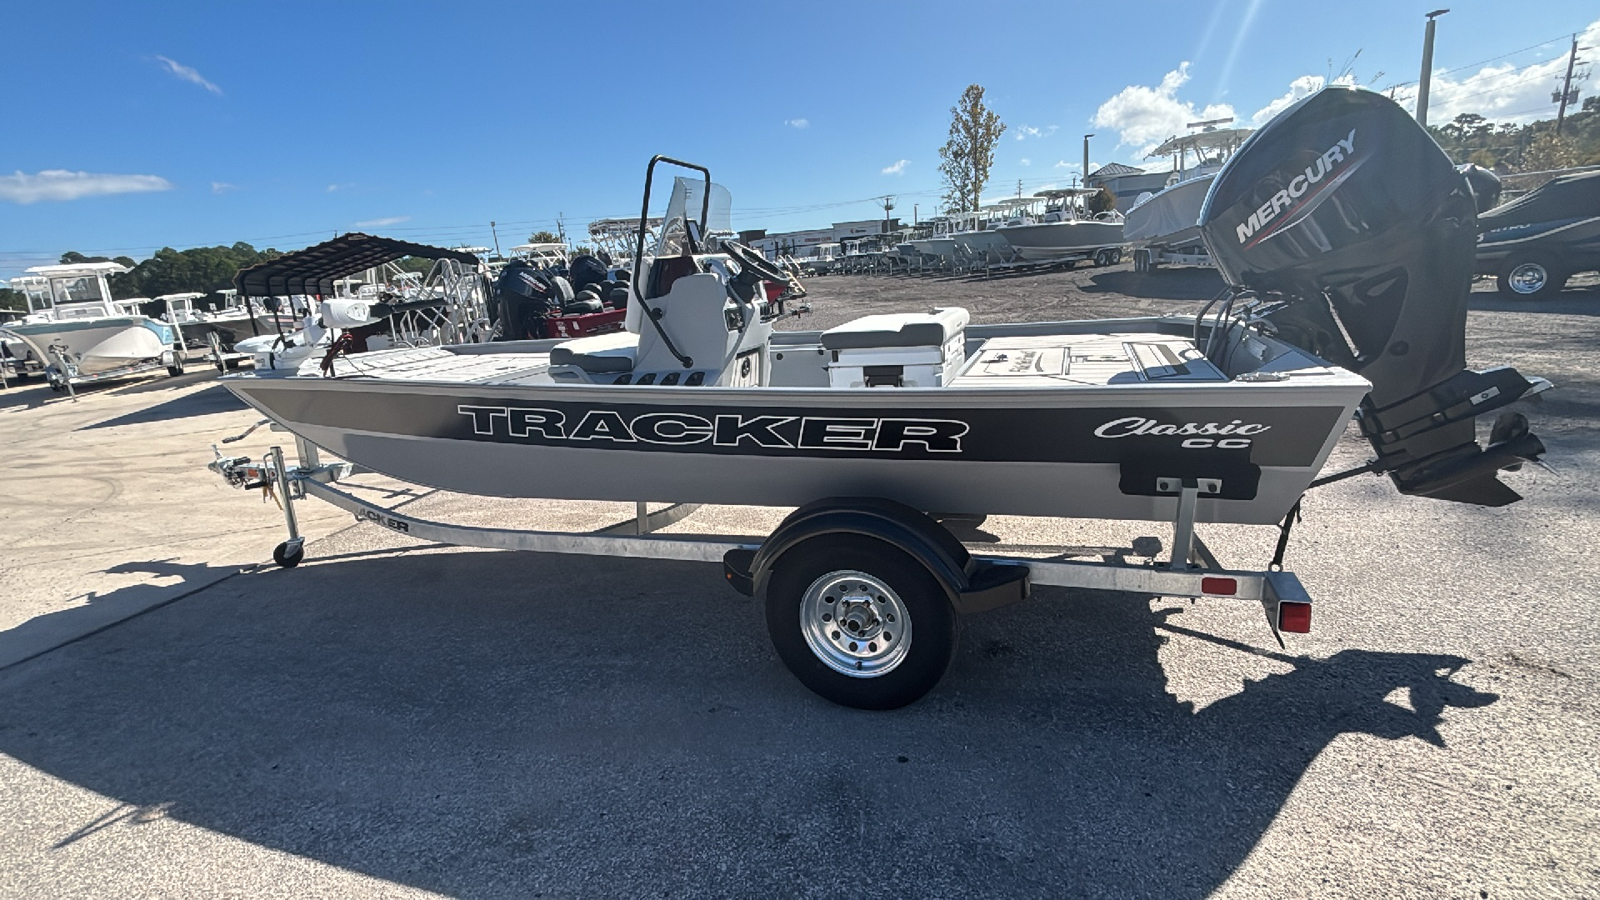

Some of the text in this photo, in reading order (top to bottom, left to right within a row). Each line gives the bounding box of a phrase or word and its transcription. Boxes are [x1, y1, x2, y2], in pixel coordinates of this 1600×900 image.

[1236, 128, 1356, 244] MERCURY
[457, 404, 969, 453] TRACKER
[1094, 416, 1271, 439] Classic
[1181, 438, 1252, 449] CC
[354, 507, 409, 533] ACKER
